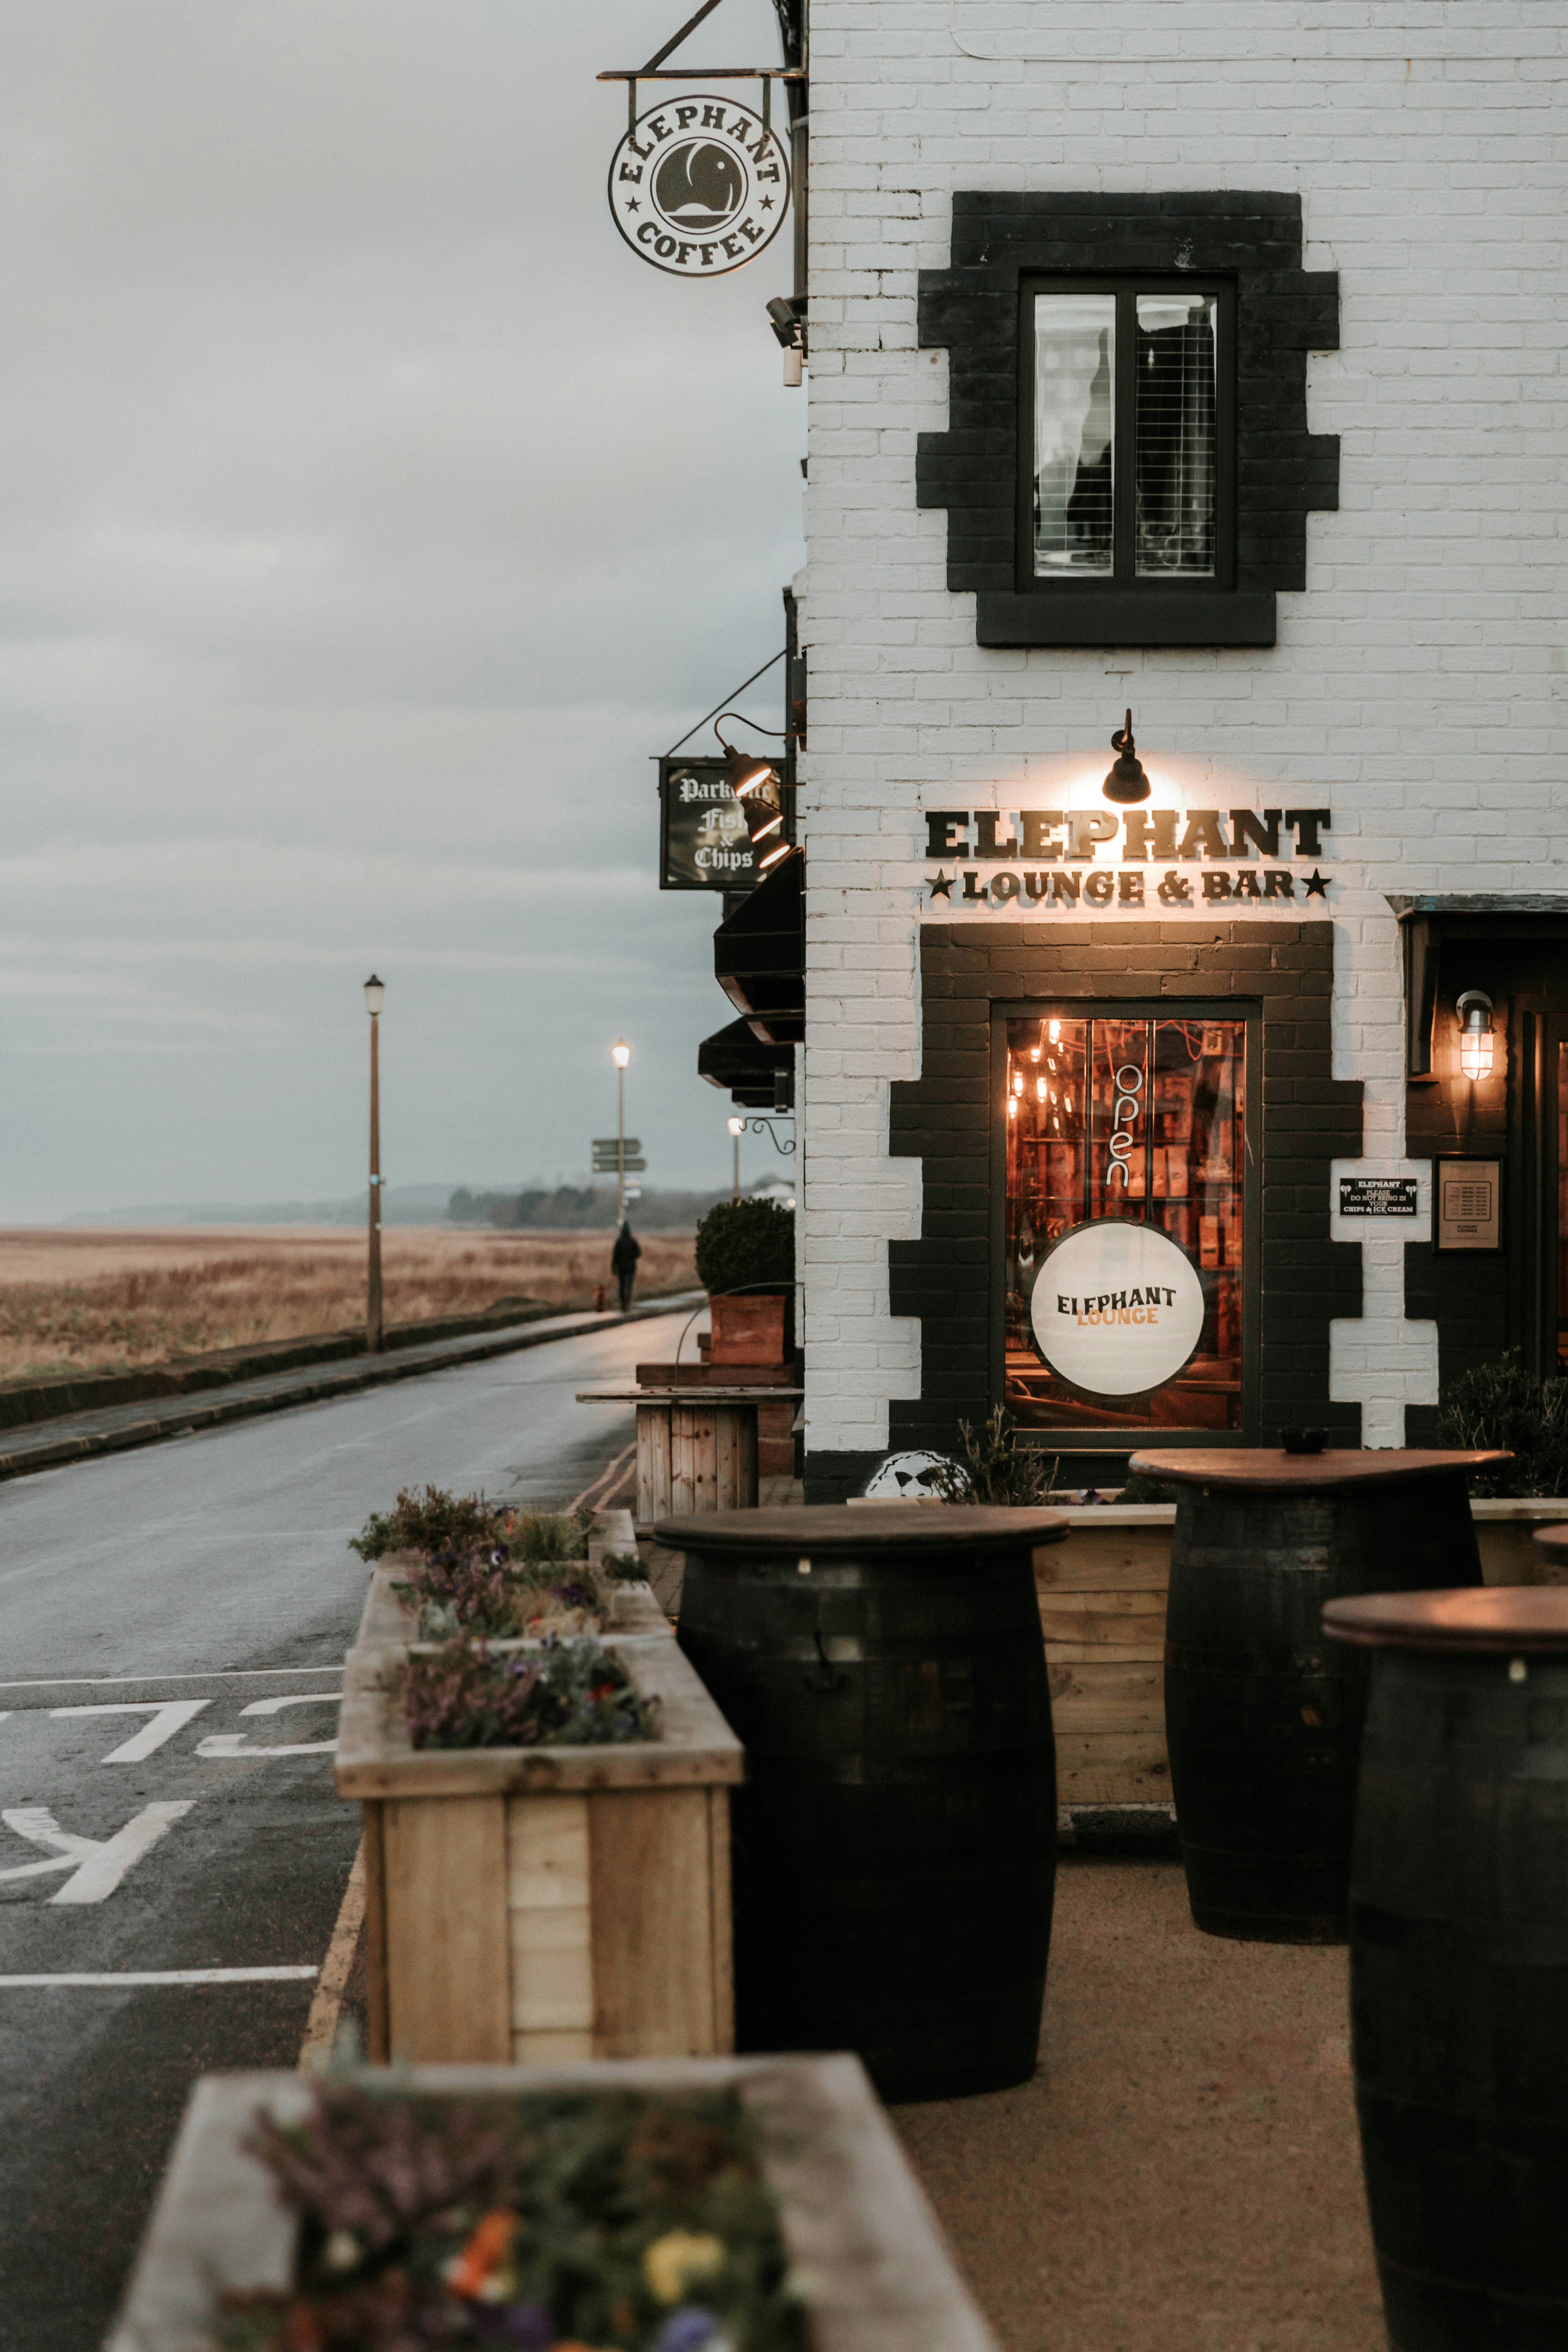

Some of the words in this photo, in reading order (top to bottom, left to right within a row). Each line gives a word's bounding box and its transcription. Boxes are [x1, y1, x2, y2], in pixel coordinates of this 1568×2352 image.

[619, 105, 780, 184] ELEPHANT
[637, 217, 765, 265] COFFEE
[925, 809, 1331, 858] ELEPHANT
[694, 847, 754, 871] Chips
[963, 871, 1144, 900] LOUNGE
[1157, 871, 1189, 899] &
[1201, 870, 1294, 898] BAR
[1057, 1286, 1176, 1316] ELEPHANT
[1078, 1308, 1158, 1326] LOUNGE
